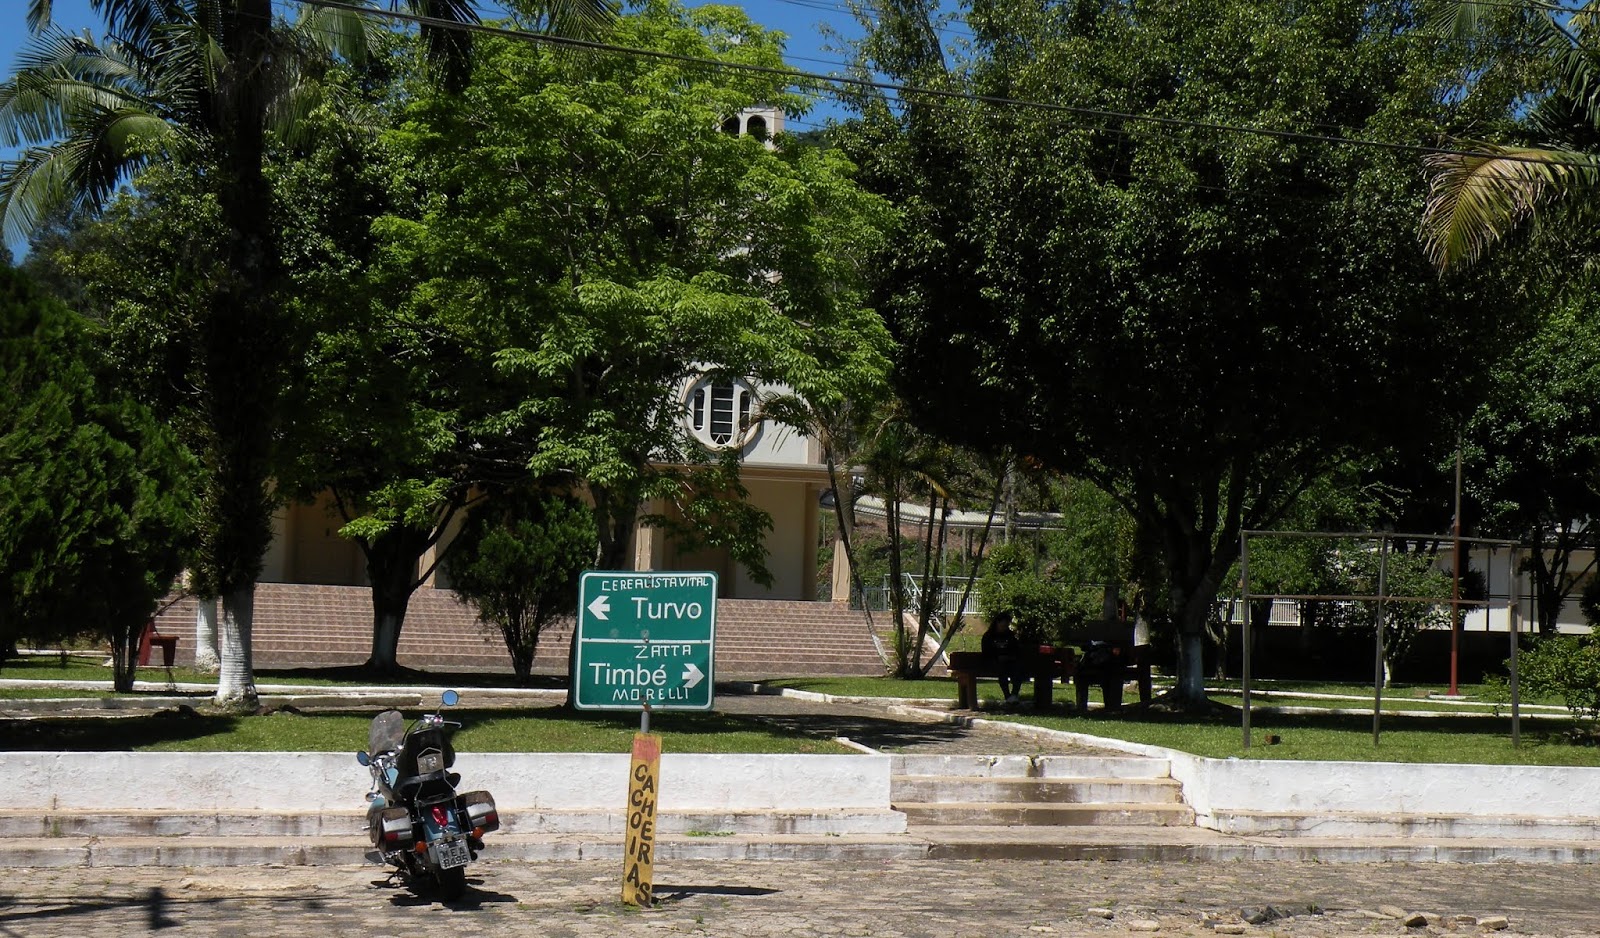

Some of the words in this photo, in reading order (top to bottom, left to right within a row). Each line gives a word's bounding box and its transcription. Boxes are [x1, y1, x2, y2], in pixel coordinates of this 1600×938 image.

[631, 596, 702, 619] Turvo
[633, 645, 692, 659] ZATTA
[588, 662, 667, 686] Timbé
[612, 687, 689, 701] MORELLI
